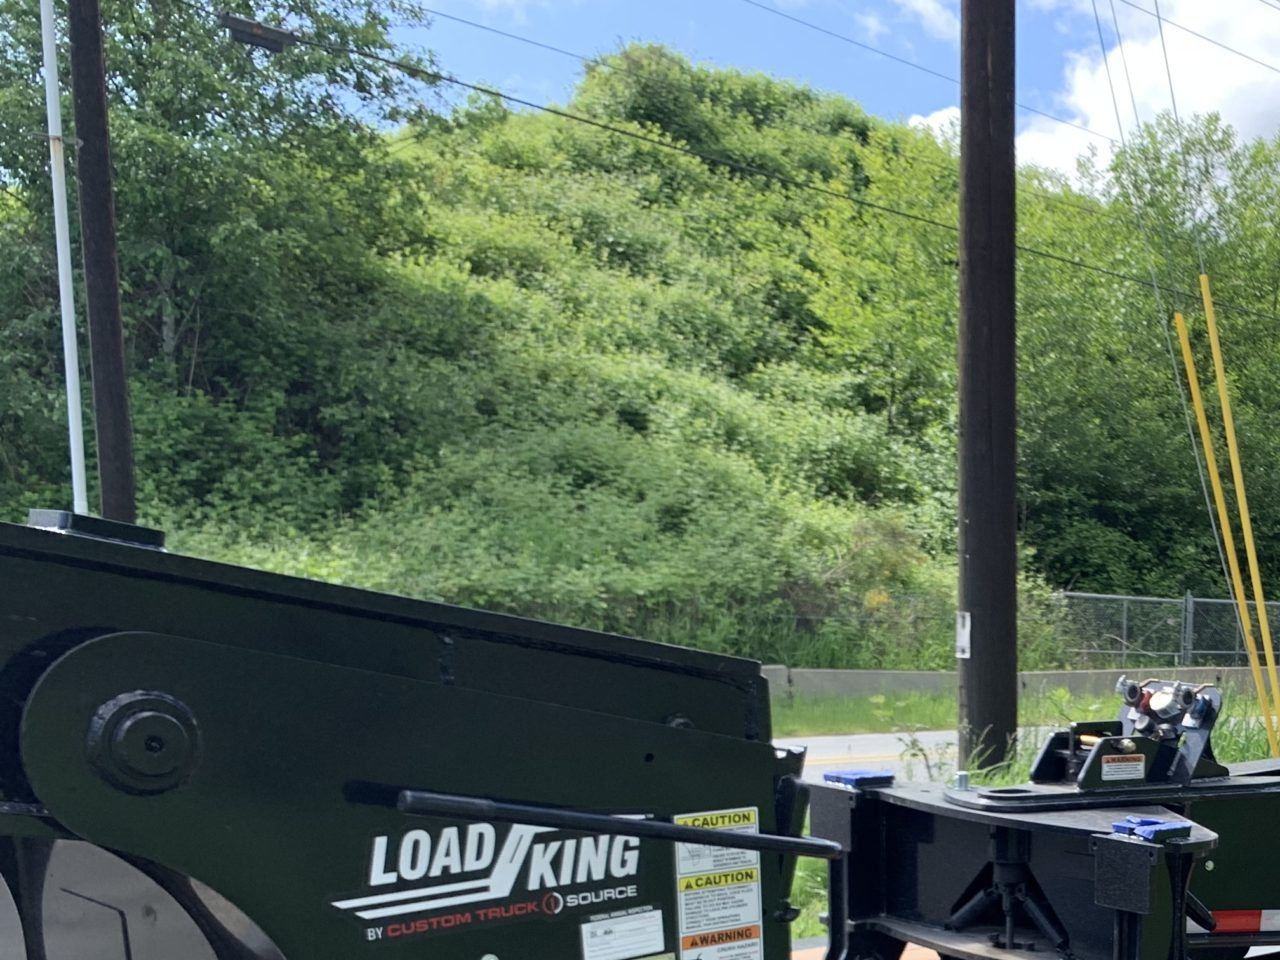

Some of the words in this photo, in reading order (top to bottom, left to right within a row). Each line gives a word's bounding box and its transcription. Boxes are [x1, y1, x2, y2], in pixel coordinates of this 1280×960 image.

[692, 813, 750, 827] CAUTION
[369, 822, 497, 886] LOAD
[527, 834, 641, 891] KING
[695, 871, 753, 887] CAUTION
[366, 927, 384, 942] BY
[386, 911, 472, 938] CUSTOM
[475, 901, 539, 921] TRUCK
[565, 885, 638, 908] SOURCE
[699, 928, 752, 946] WARNING
